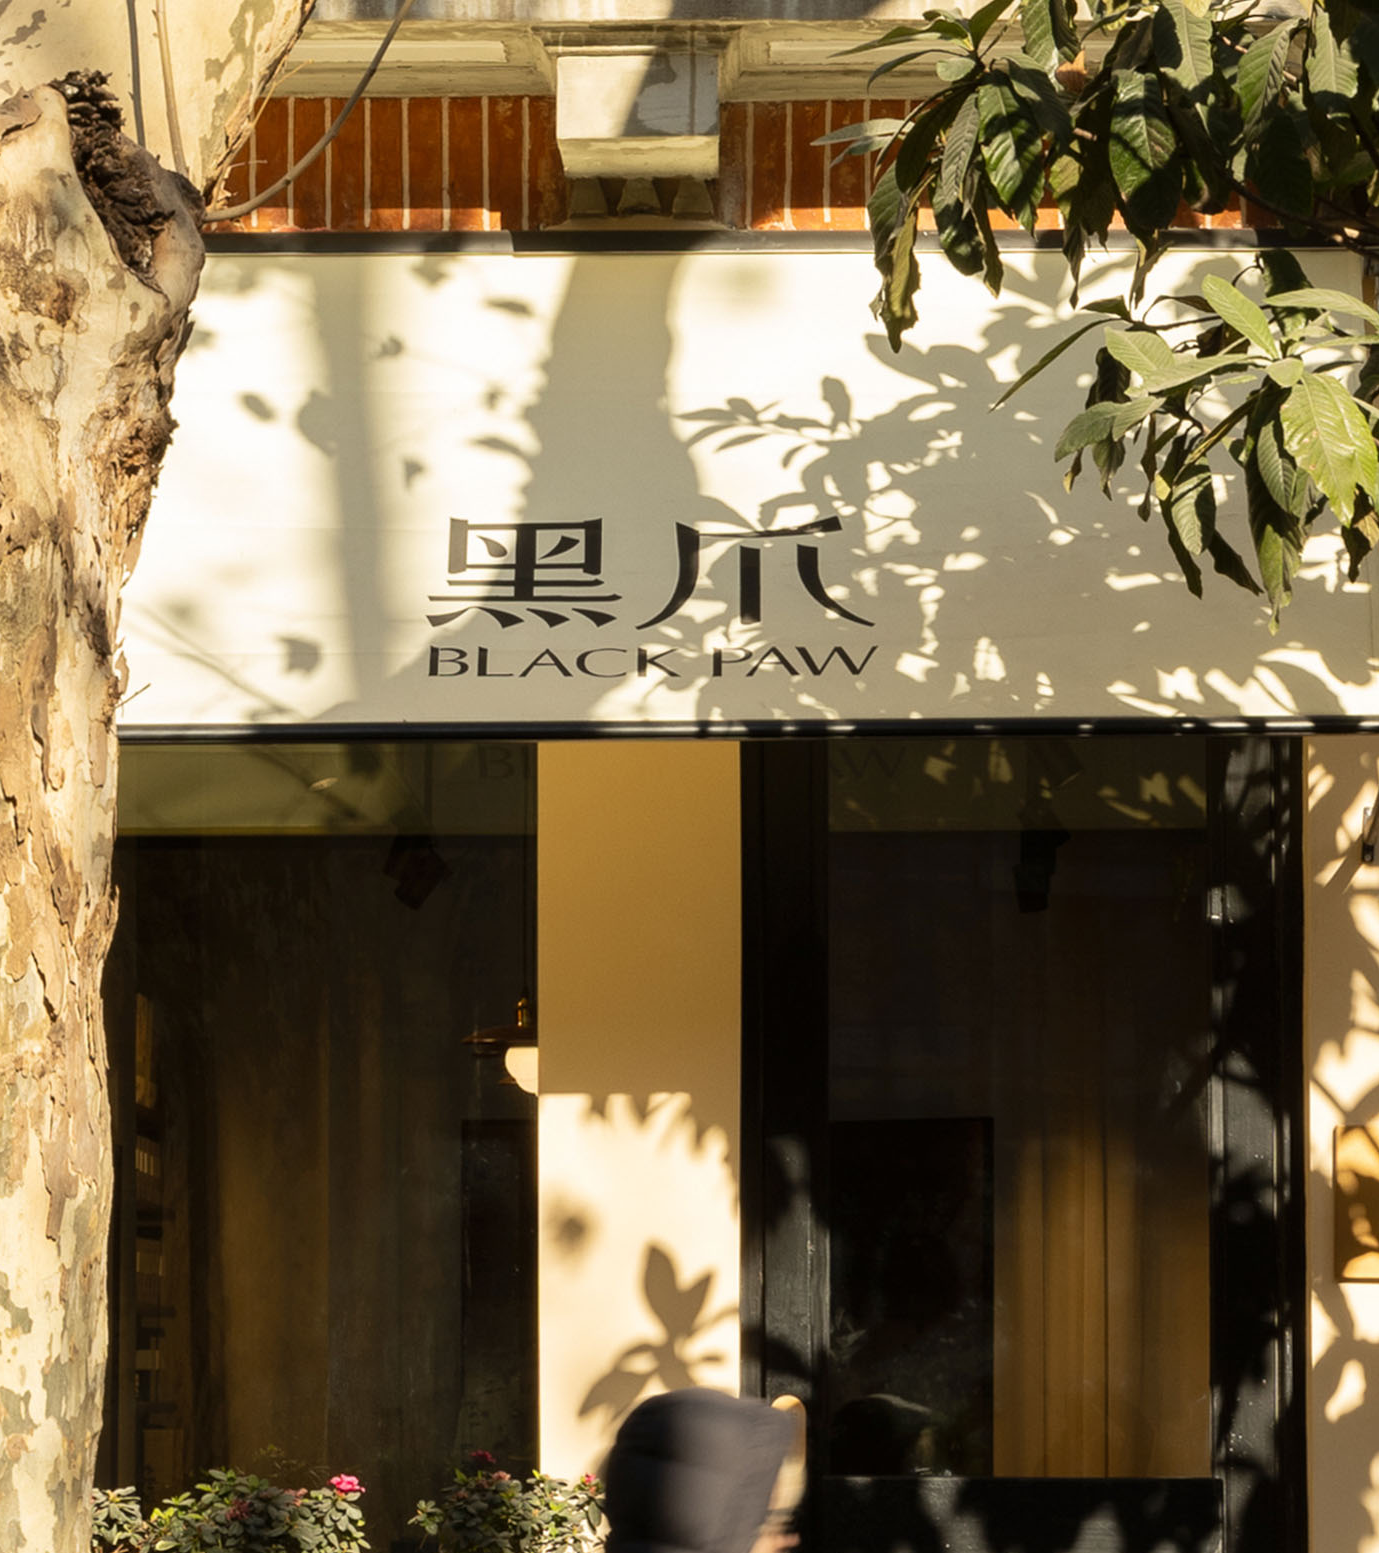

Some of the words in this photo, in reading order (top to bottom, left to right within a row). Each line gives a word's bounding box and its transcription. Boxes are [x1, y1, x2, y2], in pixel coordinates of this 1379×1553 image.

[426, 515, 876, 629] 黑爪
[427, 645, 680, 678] BLACK
[711, 645, 879, 678] PAW
